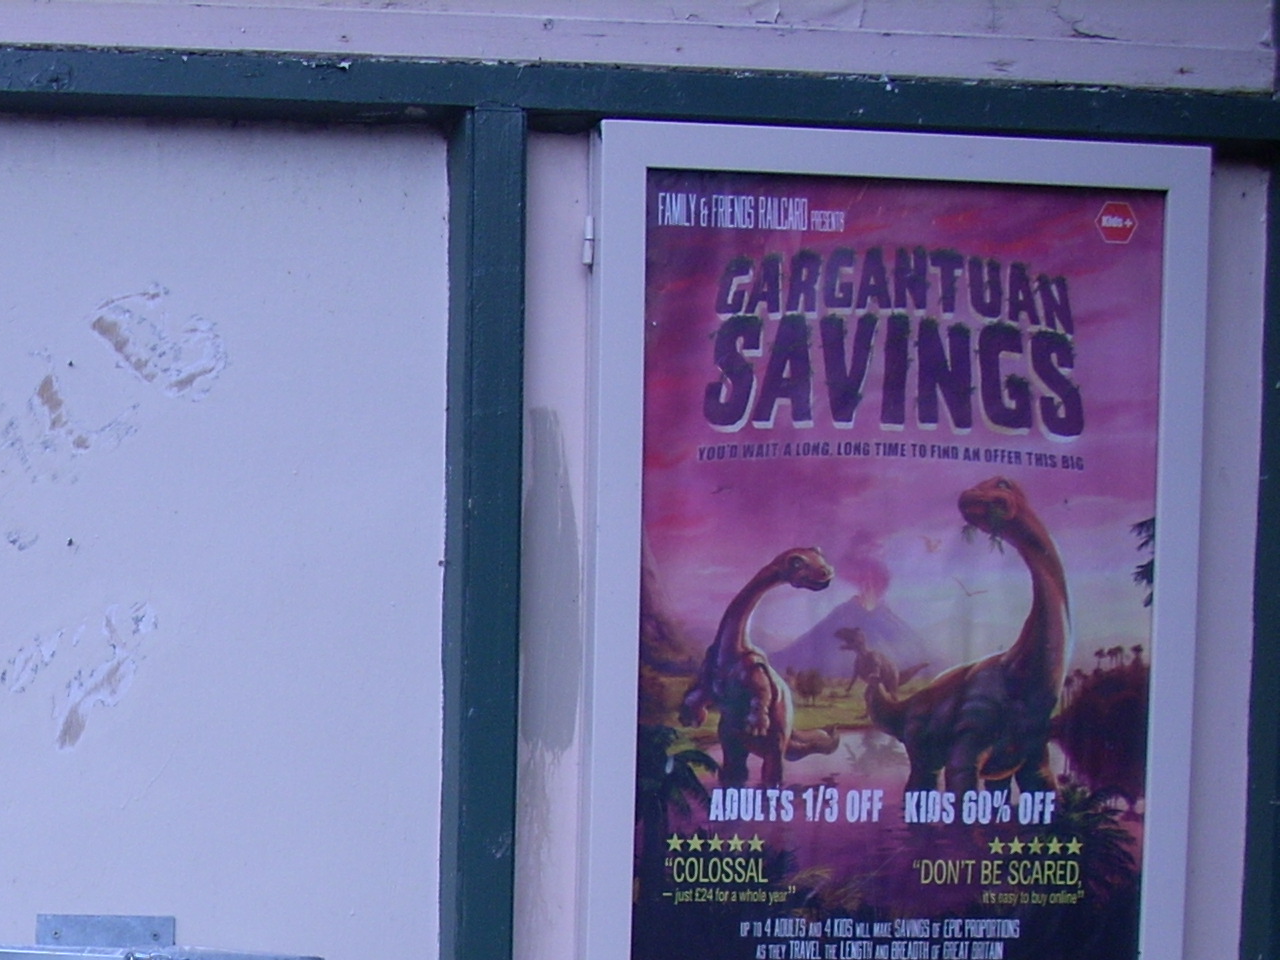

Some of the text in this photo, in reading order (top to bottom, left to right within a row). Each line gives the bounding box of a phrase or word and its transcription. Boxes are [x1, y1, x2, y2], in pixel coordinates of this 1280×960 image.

[658, 192, 845, 232] FAMILY & FRIENDS RAILCARD PRESENTS
[714, 246, 1075, 340] GARGANTUAN
[703, 314, 1085, 443] SAVINGS
[698, 444, 738, 460] YOU'D
[743, 443, 778, 458] WAIT
[783, 443, 792, 456] A
[837, 442, 870, 456] LONG
[875, 443, 906, 457] TIME
[911, 444, 927, 458] TO
[930, 445, 959, 460] FIND
[963, 447, 980, 462] AN
[985, 449, 1022, 465] OFFER
[1026, 452, 1057, 469] THIS
[1062, 455, 1084, 471] BIG
[709, 787, 883, 823] ADULTS 1/3 OFF
[905, 790, 1056, 825] KIDS 60% OFF
[980, 860, 1003, 884] BE
[1007, 860, 1082, 888] SCARED,
[674, 888, 692, 905] just
[694, 888, 713, 902] £24
[715, 888, 729, 902] for
[731, 891, 737, 902] a
[738, 888, 766, 902] whole
[999, 893, 1018, 906] easy
[1020, 892, 1028, 904] to
[1031, 891, 1046, 906] buy
[740, 918, 1020, 938] UP TO 4 ADULTS AND 4 KIDS WILL MAKE SAVINGS OF EPIC PROPORTIONS
[756, 940, 1004, 960] AS THEY TRAVEL THE LENGTH AND BREADTH OF GREAT BRITAIN
